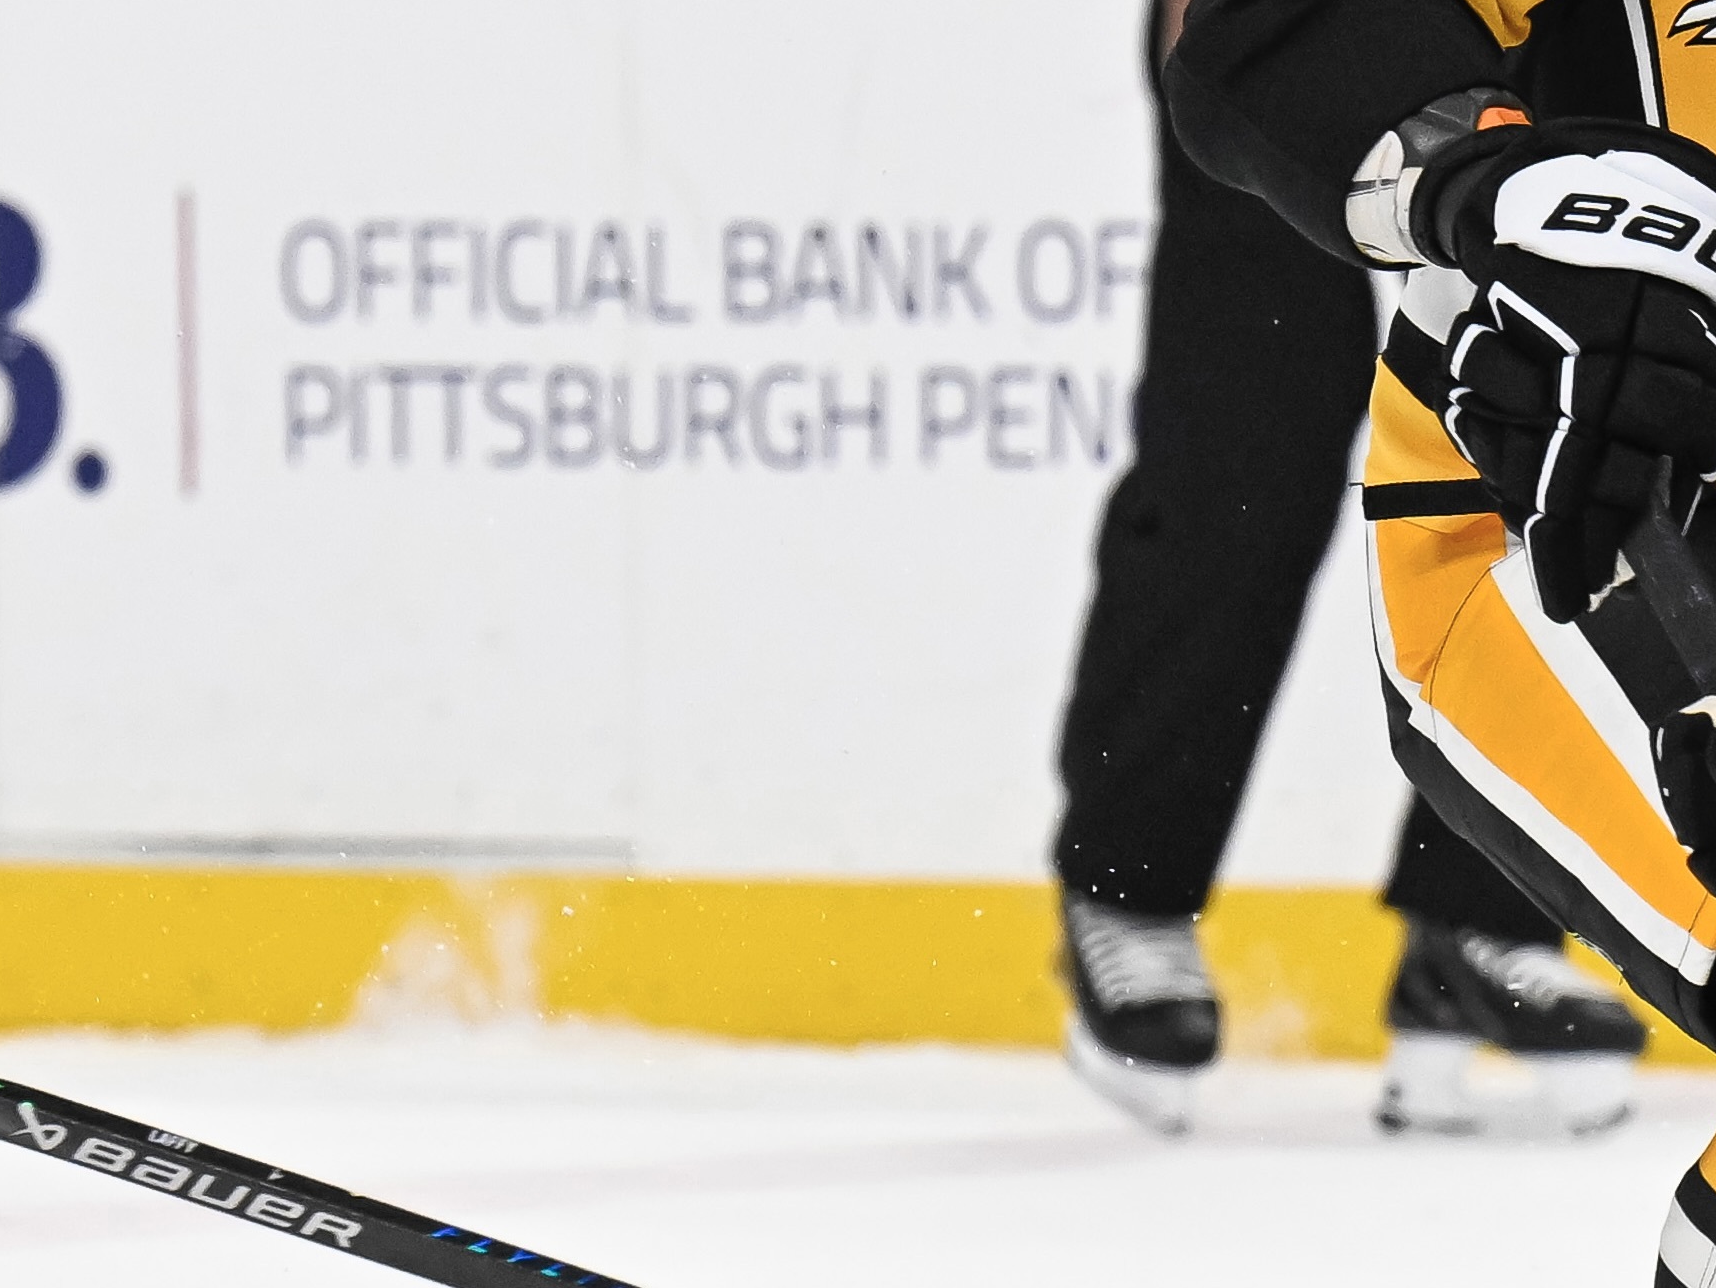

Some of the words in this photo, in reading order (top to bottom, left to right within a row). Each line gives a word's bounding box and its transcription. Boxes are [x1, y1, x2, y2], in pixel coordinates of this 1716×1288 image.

[279, 218, 691, 325] OFFICIAL
[722, 218, 990, 323] BANK
[287, 364, 889, 470] PITTSBURGH
